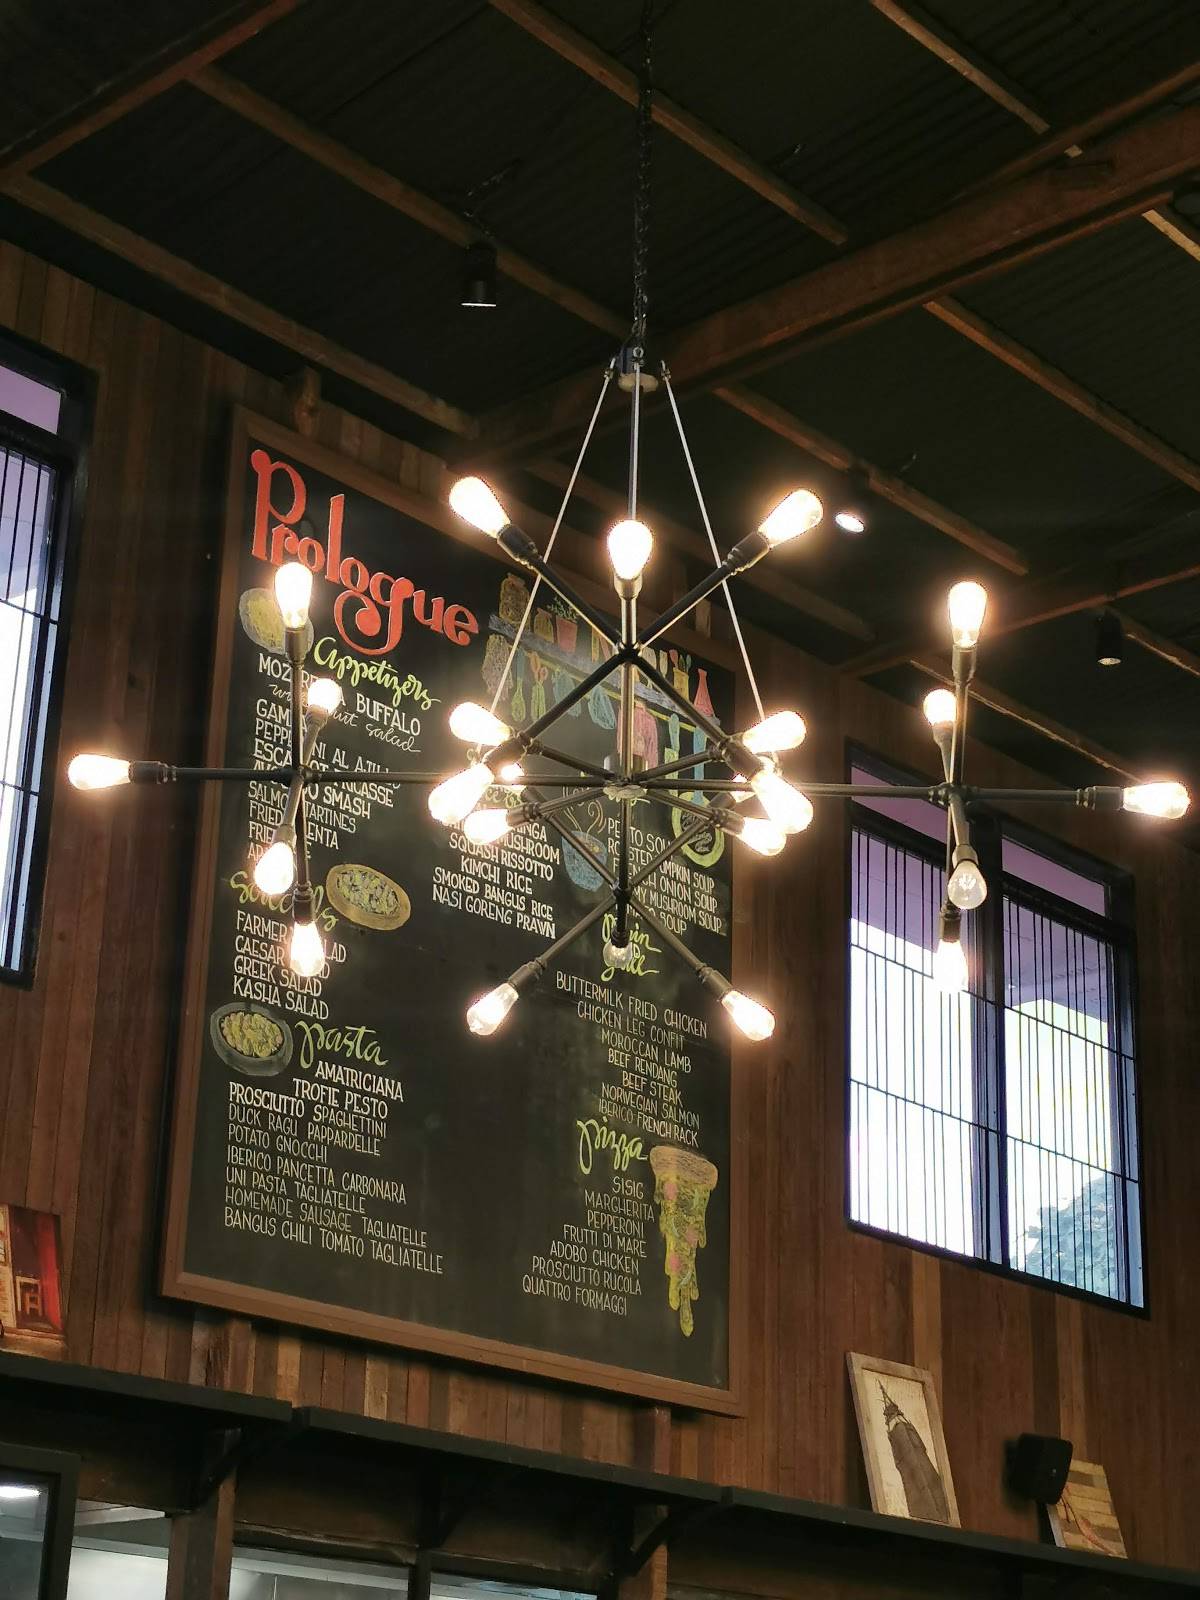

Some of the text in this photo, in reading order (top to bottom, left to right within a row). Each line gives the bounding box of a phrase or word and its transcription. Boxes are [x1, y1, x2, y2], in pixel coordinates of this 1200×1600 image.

[250, 449, 479, 655] Prologue
[356, 692, 422, 736] BUFFALO
[332, 748, 349, 768] AL
[365, 723, 421, 752] salad
[249, 800, 284, 826] FRIED
[304, 801, 356, 834] TARTINES
[323, 786, 371, 819] SMASH
[449, 832, 554, 881] SQUASH RISSOTTO
[497, 832, 560, 864] MUSHROOM
[608, 817, 672, 855] PETO SOU
[460, 855, 533, 895] KIMCHI RICE
[608, 837, 653, 866] ROSTED
[693, 872, 715, 892] SOUP
[432, 866, 553, 921] SMOKED BANGUS RICE
[432, 884, 556, 940] NASI GORENG PRAWN
[650, 887, 697, 922] MUSHROOM
[698, 909, 722, 935] SOUP
[659, 876, 691, 903] ONION
[694, 890, 717, 913] SOUP
[660, 911, 687, 935] SOUP
[235, 935, 286, 966] CAESAR
[234, 954, 276, 983] GREEK
[279, 968, 322, 997] SALAD
[233, 975, 329, 1020] KASHA SALAD
[556, 970, 707, 1039] BUTTERMILK FRIED CHICKEN
[577, 1001, 685, 1051] CHICKEN LEG CONFIT
[601, 1029, 692, 1073] MOROCCAN LAMB
[608, 1047, 678, 1088] BEEF RENDANG
[293, 1078, 388, 1119] TROFIE PESTO
[315, 1060, 404, 1102] AMATRICIANA
[622, 1070, 683, 1107] BEEF STEAK
[228, 1081, 387, 1138] PROSCIUTTO SPAGHETTINI
[598, 1098, 699, 1148] IBERICO FRENCH RACK
[601, 1082, 700, 1129] NORWEGIAN SALMON
[228, 1103, 381, 1156] DUCK RAGU PAPPARDELLE
[228, 1123, 328, 1163] POTATO GNOCCHI
[225, 1166, 366, 1214] UNI PASTA TAGLIATELLE
[227, 1144, 407, 1205] IBERICO PANCETTA CARBONARA
[612, 1175, 644, 1200] SISIG
[225, 1187, 427, 1248] HOMEMADE SAUSAGE TAGLIATELLE
[585, 1189, 655, 1223] MARGHERITA
[587, 1209, 644, 1237] PEPPERONI
[224, 1206, 444, 1275] BANGUS CHILI TOMATO TAGLIATELLE
[550, 1240, 639, 1276] ADOBO CHICKEN
[563, 1224, 647, 1258] FRUTTI DI MARE
[522, 1275, 627, 1316] QUATTRO FORMAGGI
[532, 1256, 641, 1295] PROSCIUTTO RUCOLA
